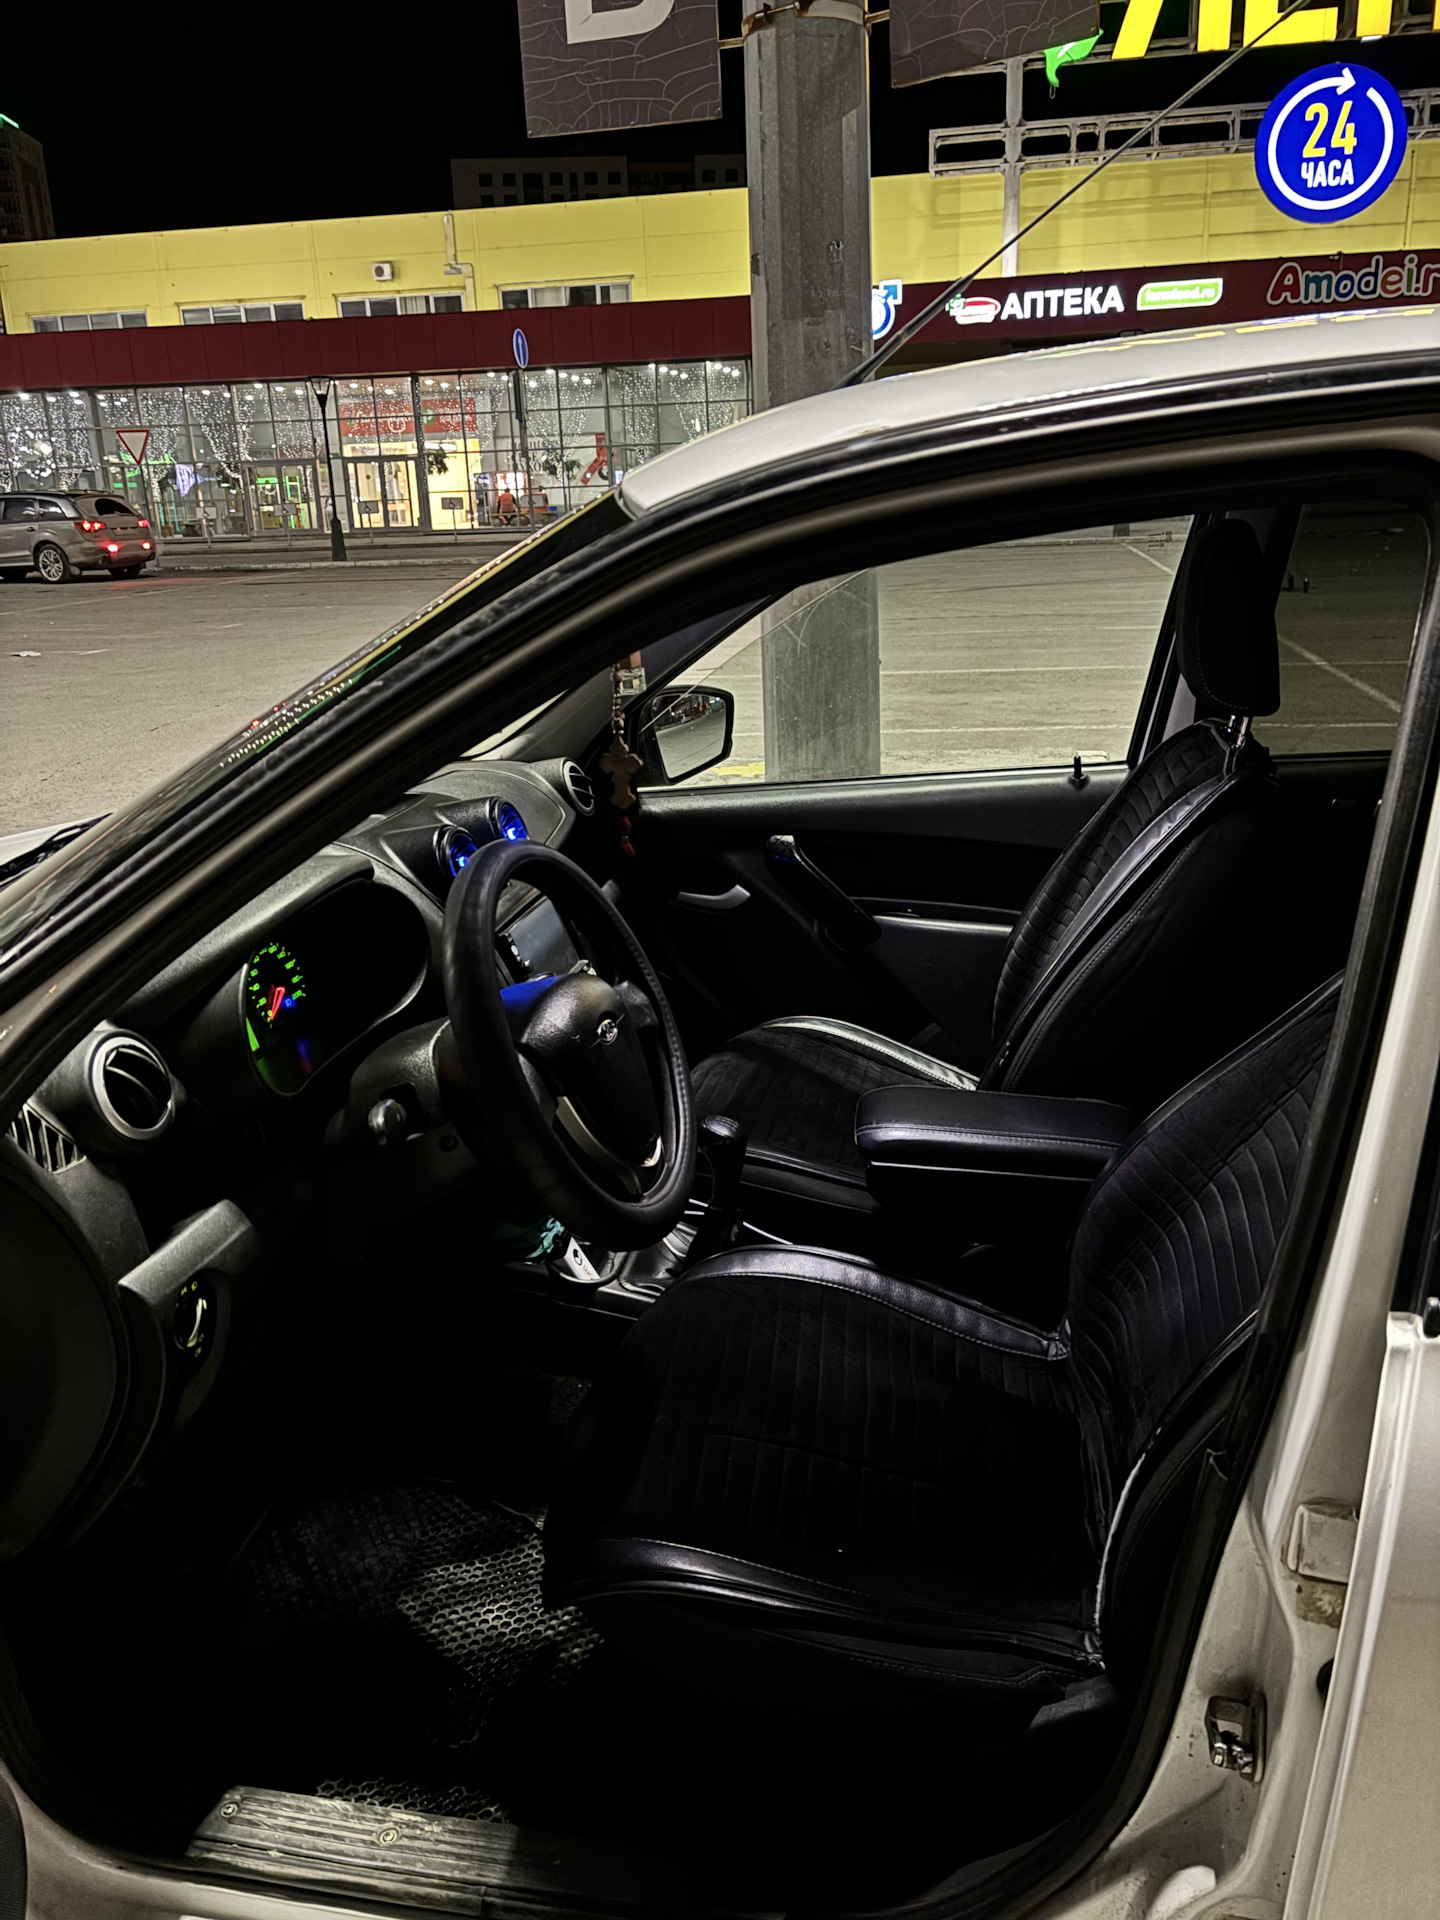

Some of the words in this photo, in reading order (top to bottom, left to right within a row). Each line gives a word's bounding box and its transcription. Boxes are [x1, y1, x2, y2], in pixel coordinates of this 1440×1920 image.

[1303, 100, 1357, 158] 24
[1301, 158, 1354, 188] ЧАСА
[1001, 285, 1125, 320] АПТЕКА
